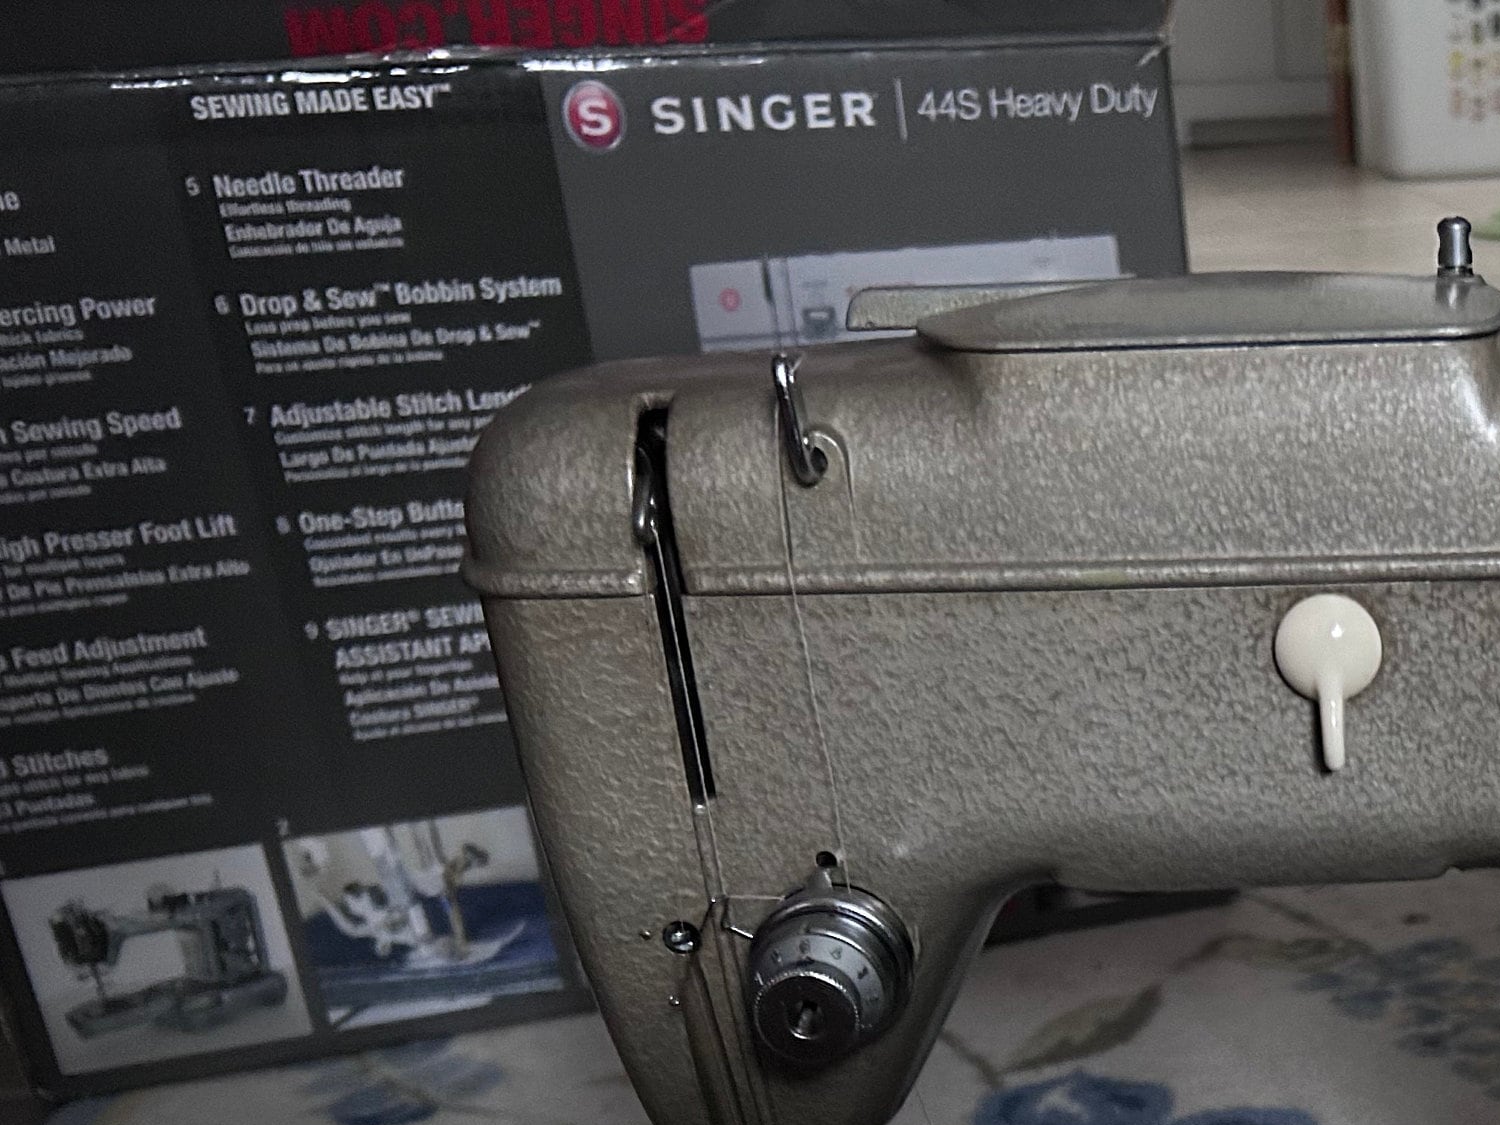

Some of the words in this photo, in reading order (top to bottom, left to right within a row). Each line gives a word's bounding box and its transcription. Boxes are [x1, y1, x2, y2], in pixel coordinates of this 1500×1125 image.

[284, 0, 709, 58] SINGER.COM
[190, 92, 292, 120] SEWING
[293, 87, 370, 115] MADE
[650, 91, 878, 135] SINGER
[917, 88, 982, 122] 44S
[988, 85, 1084, 123] Heavy
[1089, 82, 1159, 121] Duty
[184, 175, 201, 197] 5
[212, 171, 298, 198] Needle
[298, 165, 403, 193] Threader
[3, 235, 56, 257] Metal
[79, 296, 156, 321] Power
[239, 292, 299, 318] Drop
[302, 287, 323, 312] &
[394, 279, 477, 306] Bobbin
[477, 275, 563, 304] System
[11, 416, 105, 445] Sewing
[106, 405, 183, 438] Speed
[243, 406, 255, 425] 7
[269, 396, 392, 429] Adjustable
[395, 391, 463, 416] Stitch
[43, 529, 135, 555] Presser
[138, 518, 193, 545] Foot
[195, 513, 238, 539] Lift
[299, 505, 404, 535] One-Step
[10, 641, 69, 670] Feed
[73, 624, 208, 663] Adjustment
[335, 636, 452, 671] ASSISTANT
[10, 746, 109, 778] Stitches
